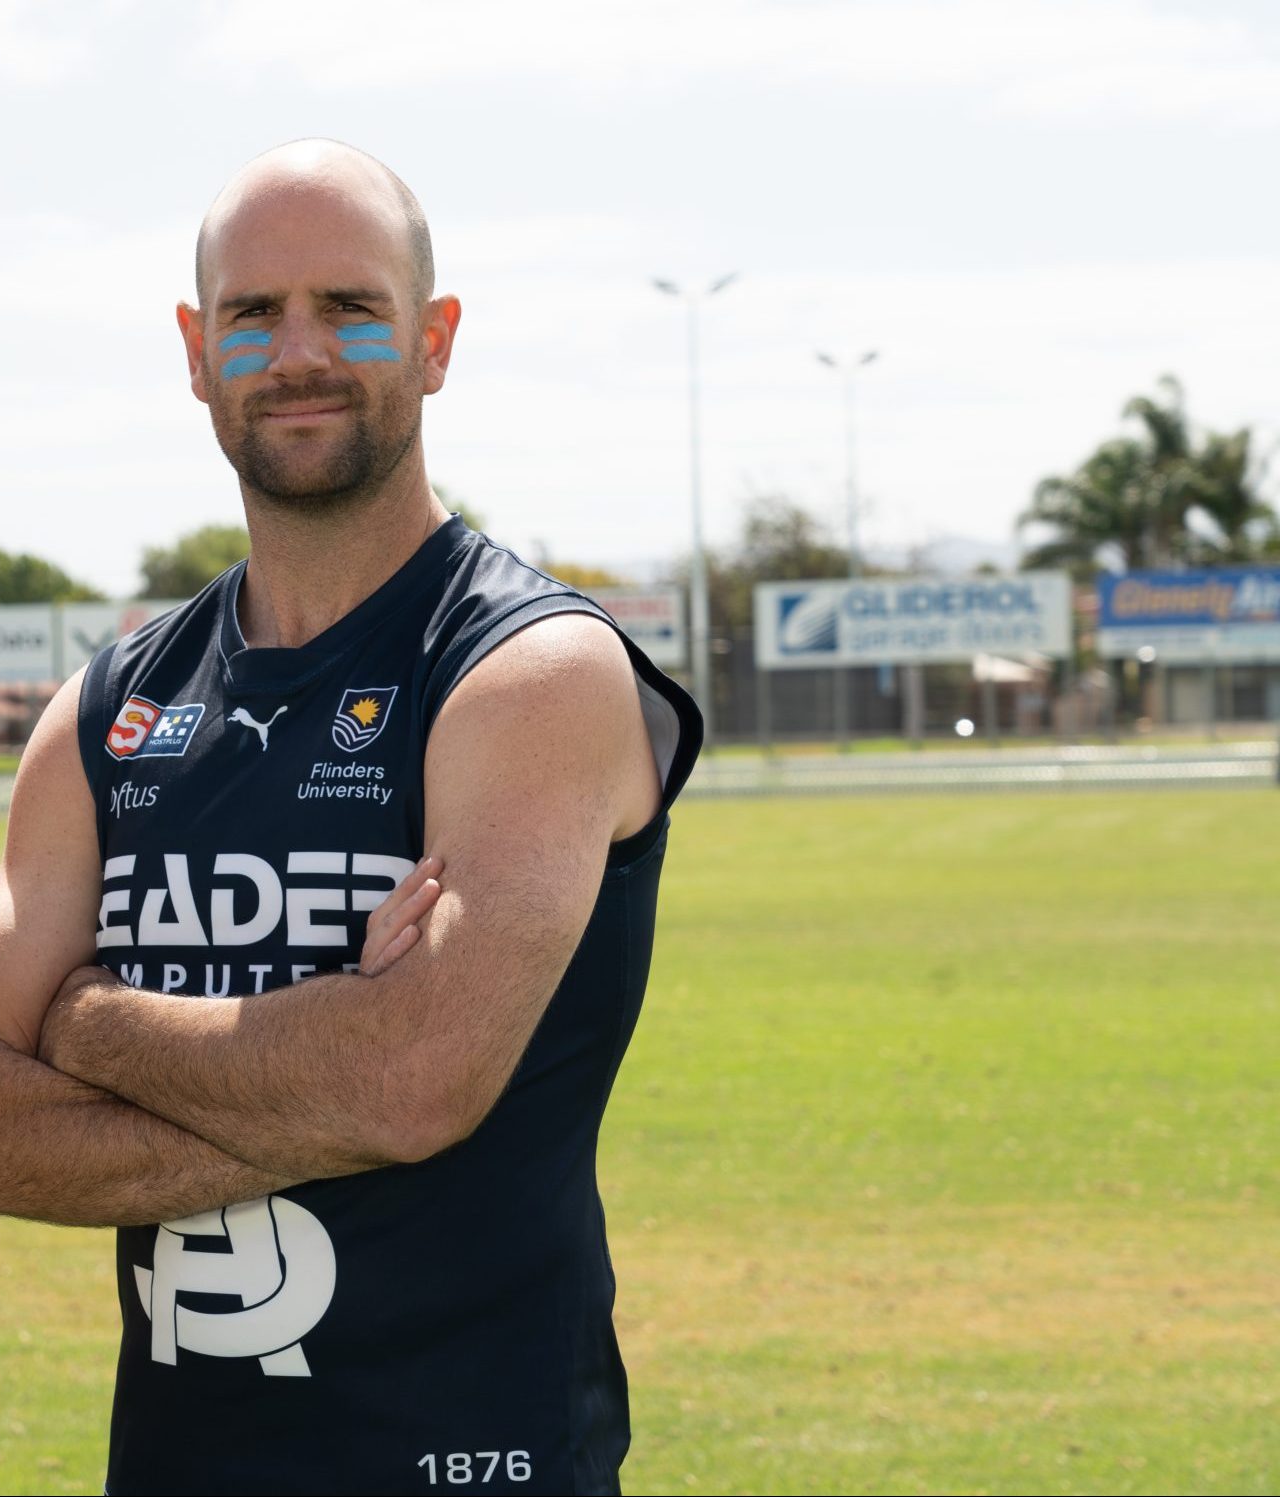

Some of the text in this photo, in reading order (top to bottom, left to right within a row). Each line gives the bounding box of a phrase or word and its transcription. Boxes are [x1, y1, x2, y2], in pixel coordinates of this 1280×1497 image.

[148, 737, 183, 746] HOSTPLUS
[309, 761, 385, 780] Flinders
[296, 781, 394, 805] University
[416, 1449, 532, 1485] 1876
